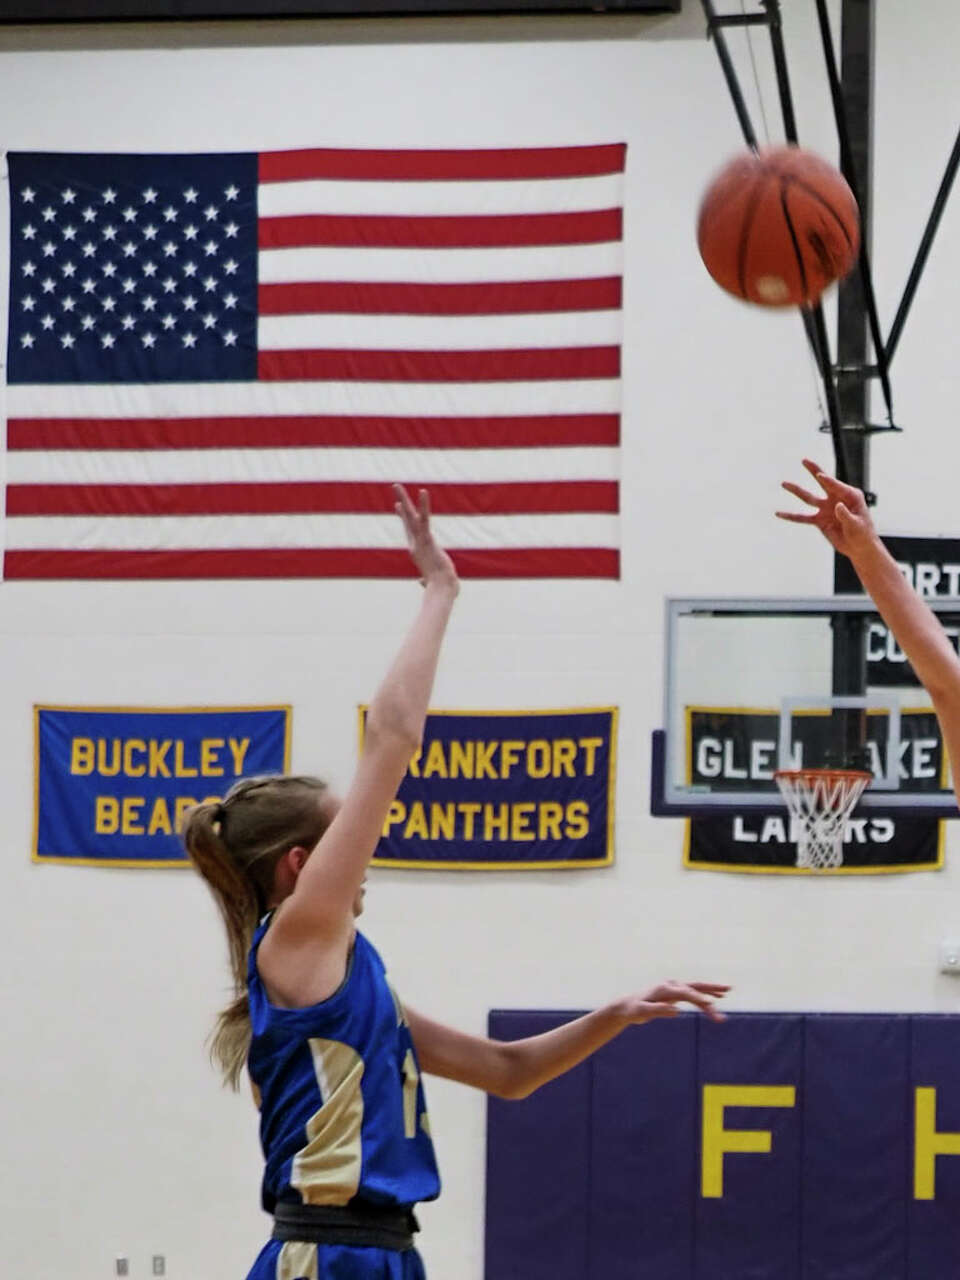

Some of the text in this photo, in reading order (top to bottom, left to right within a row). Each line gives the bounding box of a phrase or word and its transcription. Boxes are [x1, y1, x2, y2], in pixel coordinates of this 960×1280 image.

[71, 737, 250, 778] BUCKLEY
[408, 738, 603, 779] ANKFORT
[95, 796, 224, 836] BEA
[381, 799, 590, 841] PANTHERS
[732, 816, 896, 844] LARS
[701, 1084, 796, 1198] F
